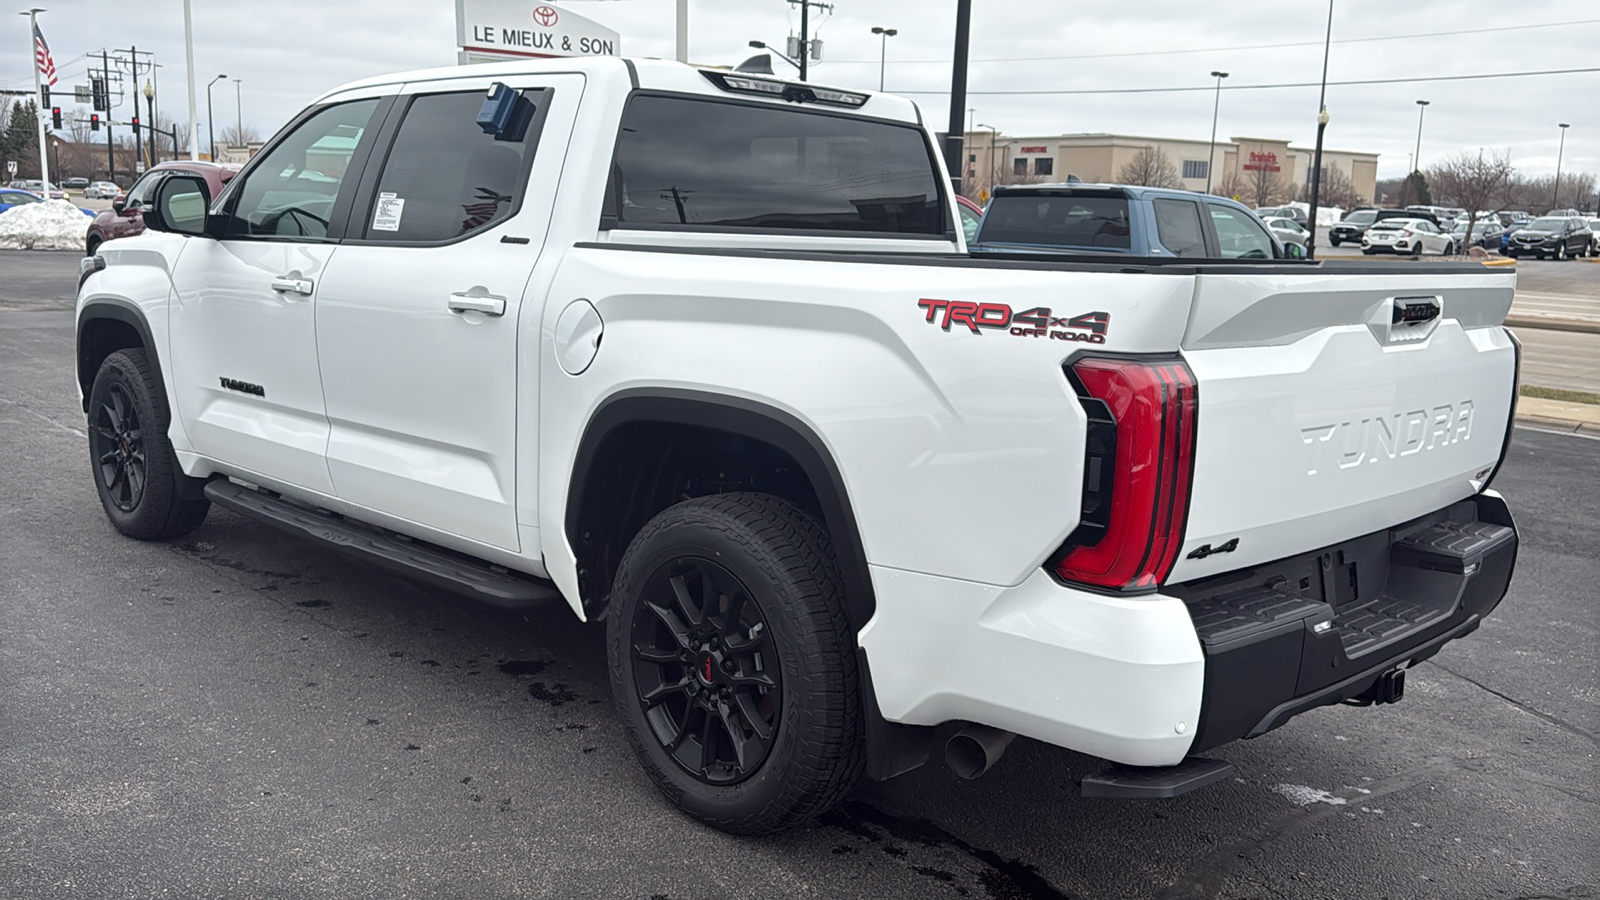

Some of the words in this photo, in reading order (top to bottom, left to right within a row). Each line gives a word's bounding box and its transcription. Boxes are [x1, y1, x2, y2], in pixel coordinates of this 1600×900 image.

[474, 25, 495, 43] LE
[502, 28, 554, 49] MIEUX
[561, 35, 572, 52] &
[580, 37, 613, 56] SON
[918, 298, 1013, 336] TRD
[1010, 327, 1047, 338] OFF
[1050, 330, 1106, 344] ROAD
[218, 376, 266, 398] TUNDRA
[1300, 399, 1475, 476] TUNDRA
